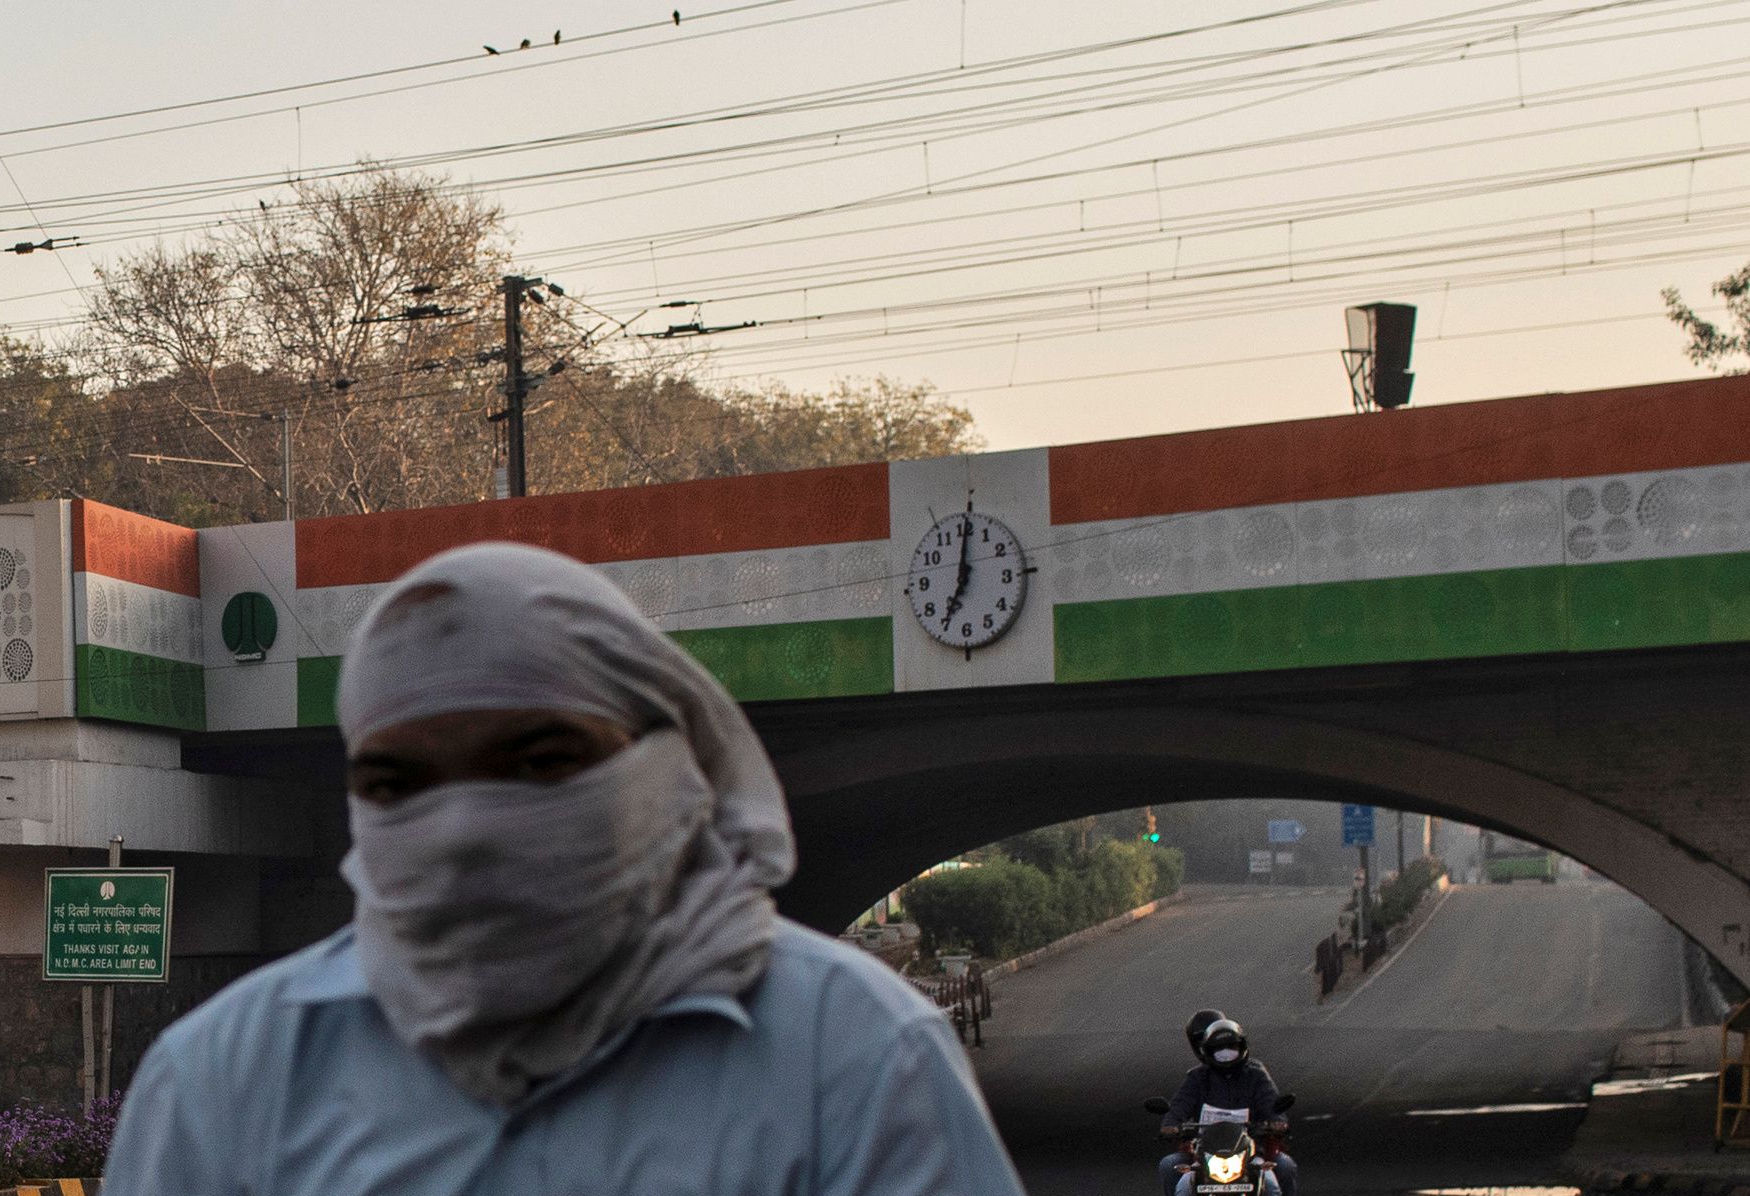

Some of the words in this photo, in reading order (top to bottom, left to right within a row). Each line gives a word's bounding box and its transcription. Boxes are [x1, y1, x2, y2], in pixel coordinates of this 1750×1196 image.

[937, 531, 951, 546] 11
[982, 528, 990, 542] 1
[995, 543, 1006, 557] 2
[924, 550, 940, 566] 10
[1002, 569, 1012, 583] 3
[919, 577, 930, 591] 9
[924, 602, 935, 617] 8
[996, 597, 1006, 611] 4
[941, 616, 951, 632] 7
[983, 614, 993, 629] 5
[961, 623, 972, 637] 6
[54, 903, 65, 919] नई
[64, 944, 96, 955] THANKS
[98, 944, 120, 955] VISIT
[90, 958, 113, 969] AREA
[115, 958, 137, 969] LIMIT
[139, 958, 156, 969] END
